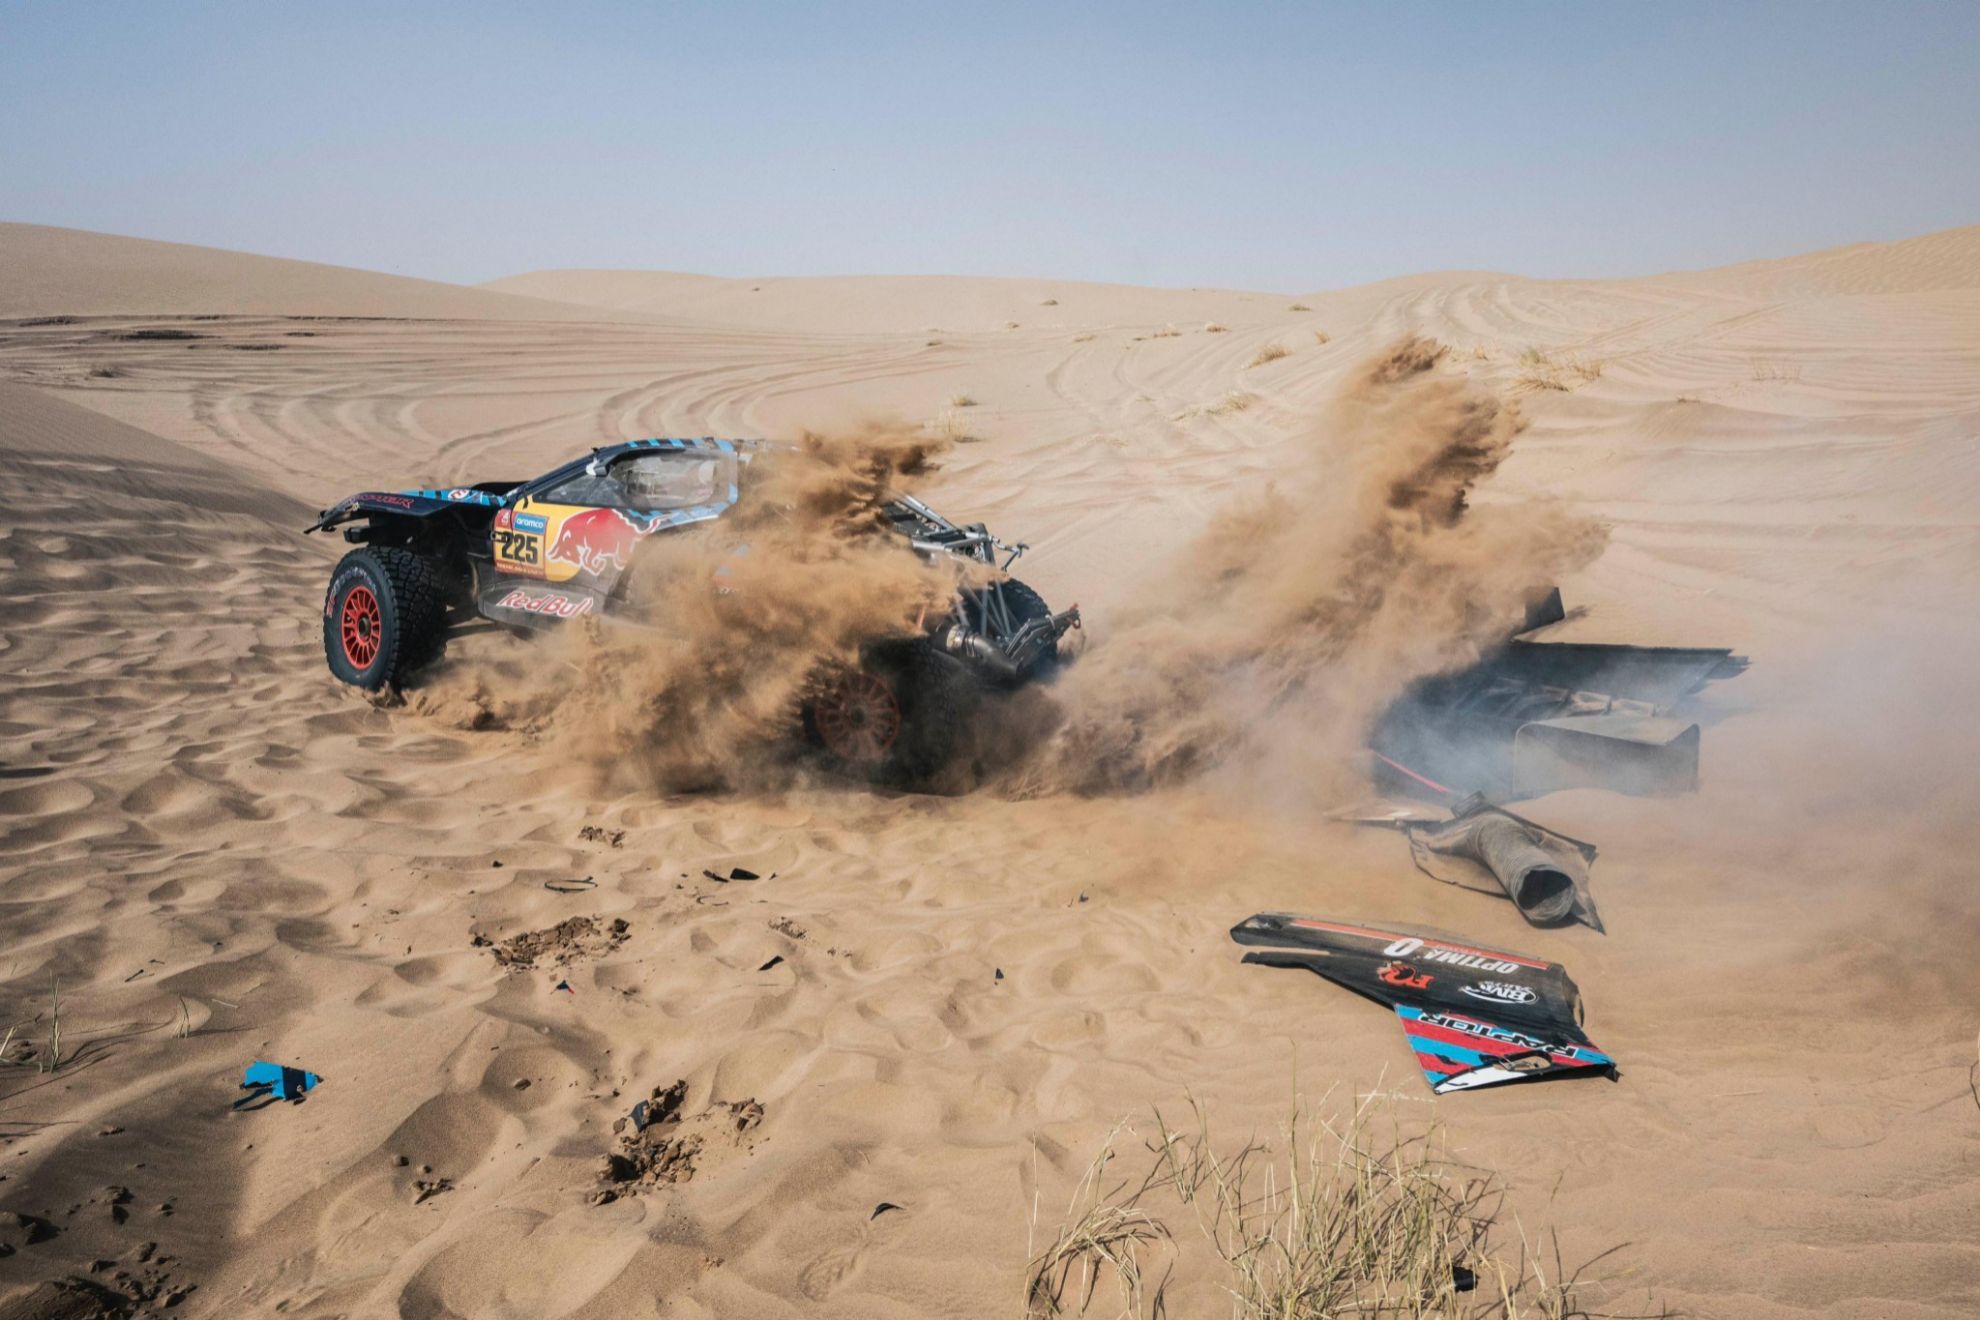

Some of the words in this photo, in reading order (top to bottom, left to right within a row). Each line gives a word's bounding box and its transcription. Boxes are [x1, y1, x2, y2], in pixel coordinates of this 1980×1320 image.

[516, 518, 544, 529] aramco
[501, 532, 538, 565] 225
[497, 591, 546, 612] Red
[540, 594, 593, 617] Bull
[1425, 949, 1520, 974] OPTIMA
[1418, 1011, 1578, 1058] RAPTOR
